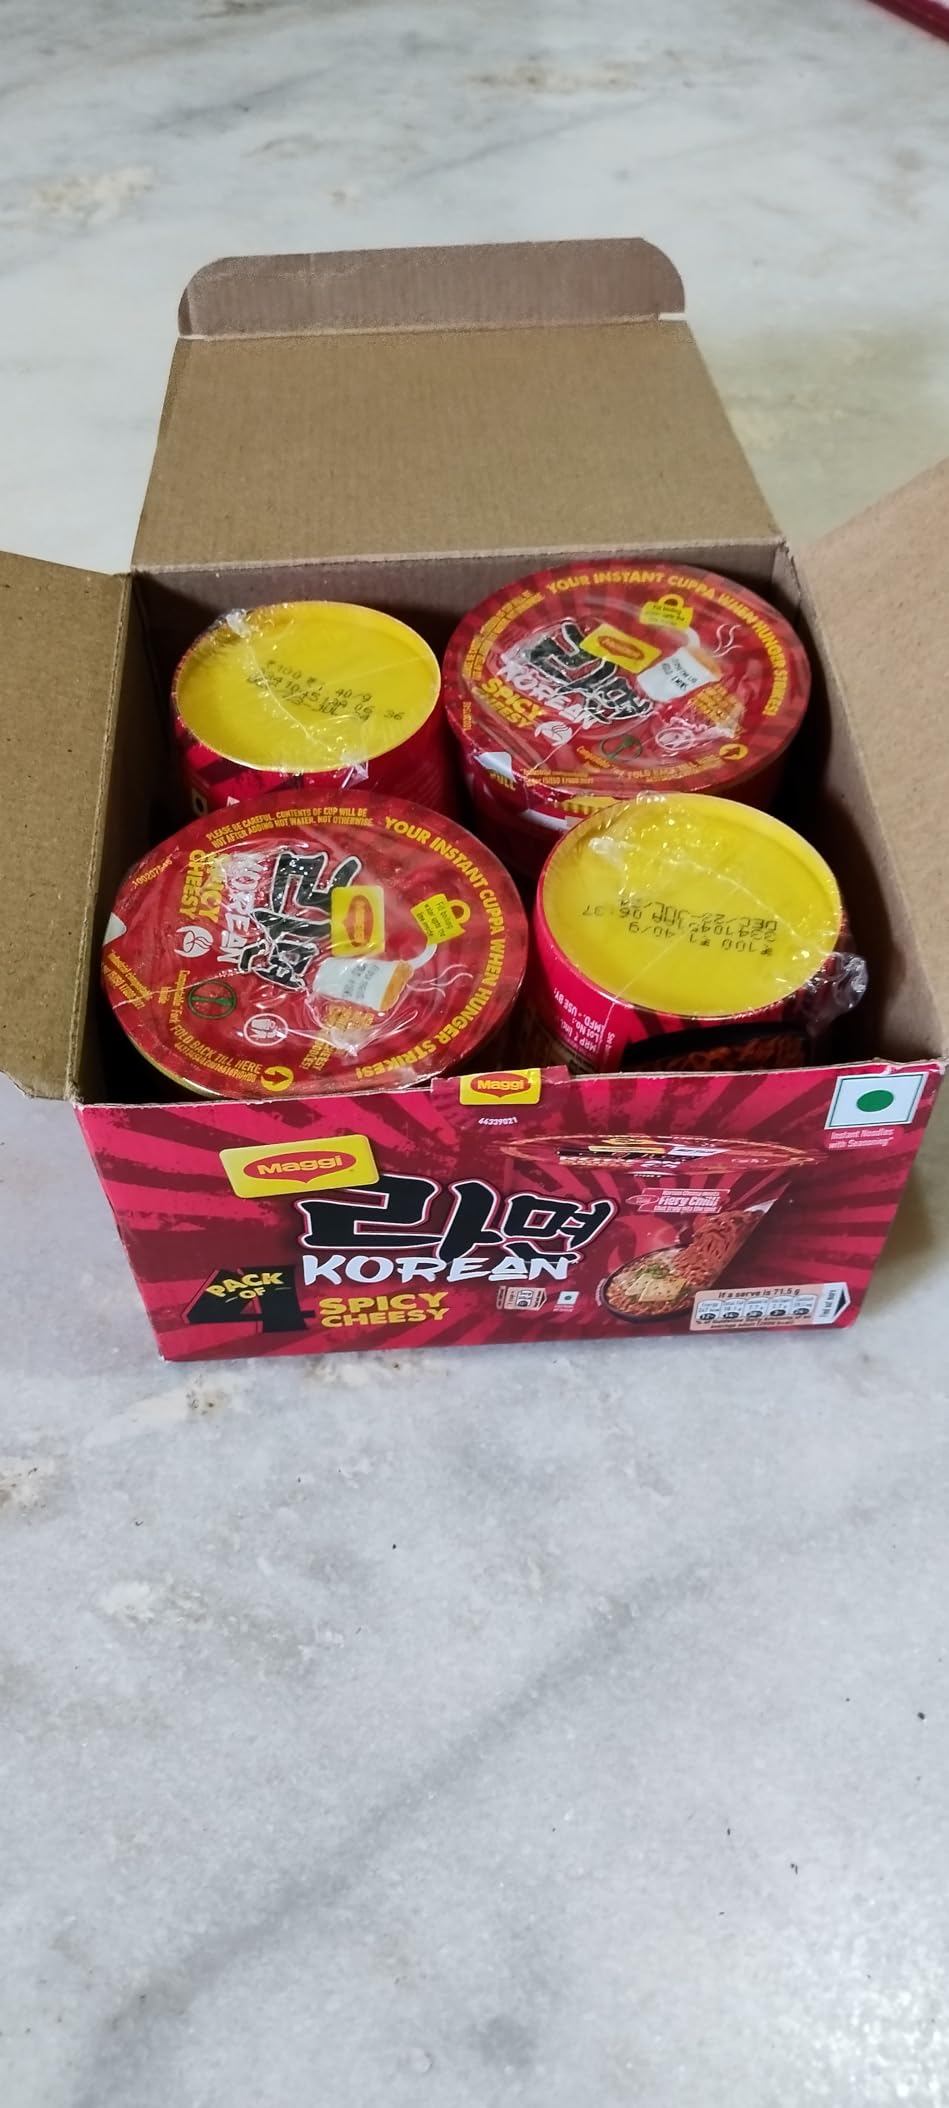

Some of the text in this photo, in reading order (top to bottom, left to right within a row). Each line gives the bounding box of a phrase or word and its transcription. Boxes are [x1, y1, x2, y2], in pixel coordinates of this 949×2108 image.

[546, 575, 591, 594] YOUR
[594, 570, 664, 584] INSTANT
[668, 575, 715, 599] CUPPA
[718, 593, 759, 625] WHEN
[751, 619, 787, 669] HUNGER
[482, 678, 543, 721] SPICY
[206, 826, 233, 841] PLEASE
[276, 808, 311, 818] CONTENTS
[312, 807, 322, 817] OF
[323, 806, 338, 816] CUP
[339, 807, 357, 817] WILL
[385, 816, 431, 844] YOUR
[429, 836, 490, 889] INSTANT
[179, 849, 205, 921] CHEESY
[217, 852, 268, 964] KOREAN
[479, 889, 505, 935] CUPPA
[481, 938, 506, 985] WHEN
[439, 988, 493, 1046] HUNGER
[564, 1001, 578, 1017] USE
[170, 1024, 192, 1047] FOLD
[190, 1039, 213, 1058] BACK
[214, 1053, 234, 1066] TILL
[235, 1060, 263, 1074] HERE
[355, 1041, 437, 1080] STRIKES!
[477, 1079, 524, 1091] Maggi
[831, 1128, 895, 1140] Instant Noodles
[257, 1155, 343, 1175] Maggi
[296, 1173, 617, 1264] 라면
[658, 1196, 689, 1207] Fiery
[206, 1272, 284, 1298] PACK
[302, 1255, 569, 1286] KOREAN
[183, 1265, 315, 1333] 4
[238, 1287, 266, 1300] OF
[319, 1291, 449, 1315] SPICY
[321, 1307, 450, 1328] CHEESY
